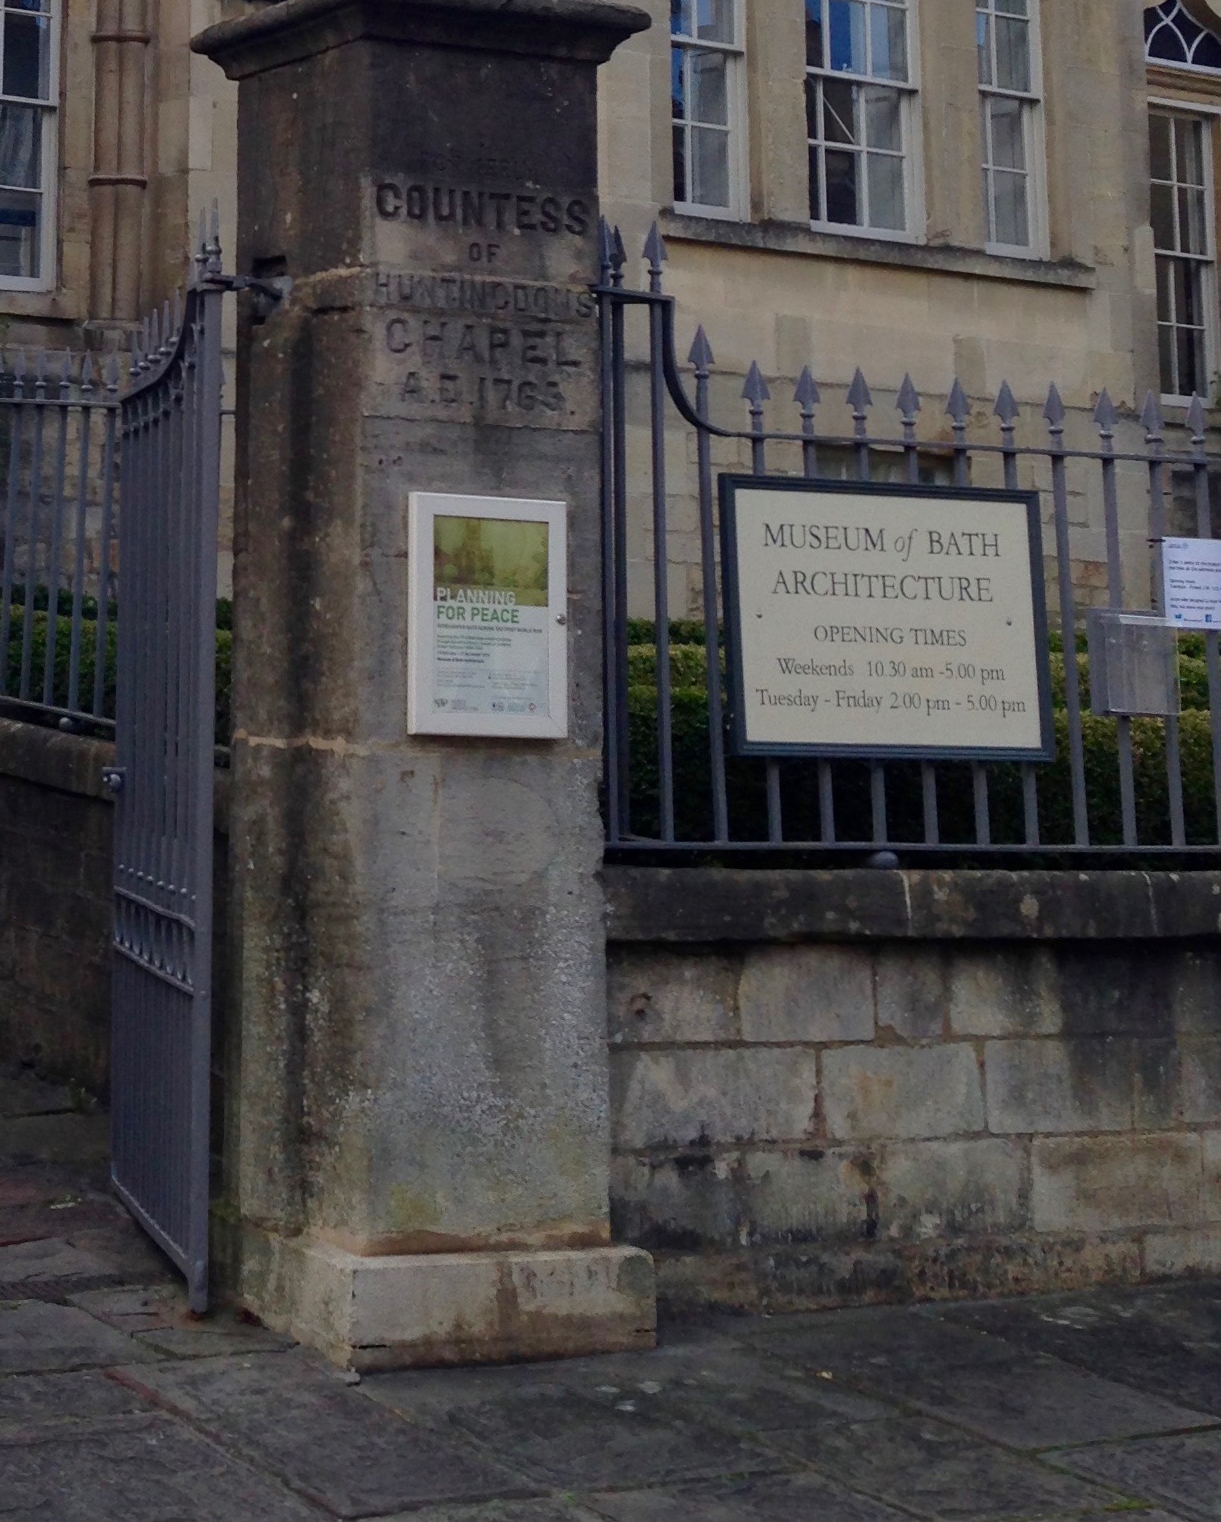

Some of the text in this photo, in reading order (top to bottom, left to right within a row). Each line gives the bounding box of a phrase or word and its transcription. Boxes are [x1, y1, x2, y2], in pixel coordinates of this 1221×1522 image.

[376, 182, 591, 236] COUNTESS
[468, 242, 501, 263] OF
[385, 317, 582, 368] CHAPEL
[762, 523, 1001, 562] MUSEUM of BATH
[437, 587, 517, 605] PLANNING
[771, 570, 994, 603] ARCHITECTURE
[436, 606, 520, 623] FOR PEACE
[813, 625, 967, 647] OPENING TIMES
[777, 657, 854, 676] Weekends
[867, 660, 906, 678] 10.30
[910, 665, 934, 678] am
[980, 668, 1005, 686] pm
[755, 688, 819, 712] Tuesday
[835, 689, 883, 713] Friday
[890, 692, 921, 709] 2.00
[926, 697, 950, 716] pm
[967, 694, 997, 711] 5.00
[1001, 700, 1026, 718] pm
